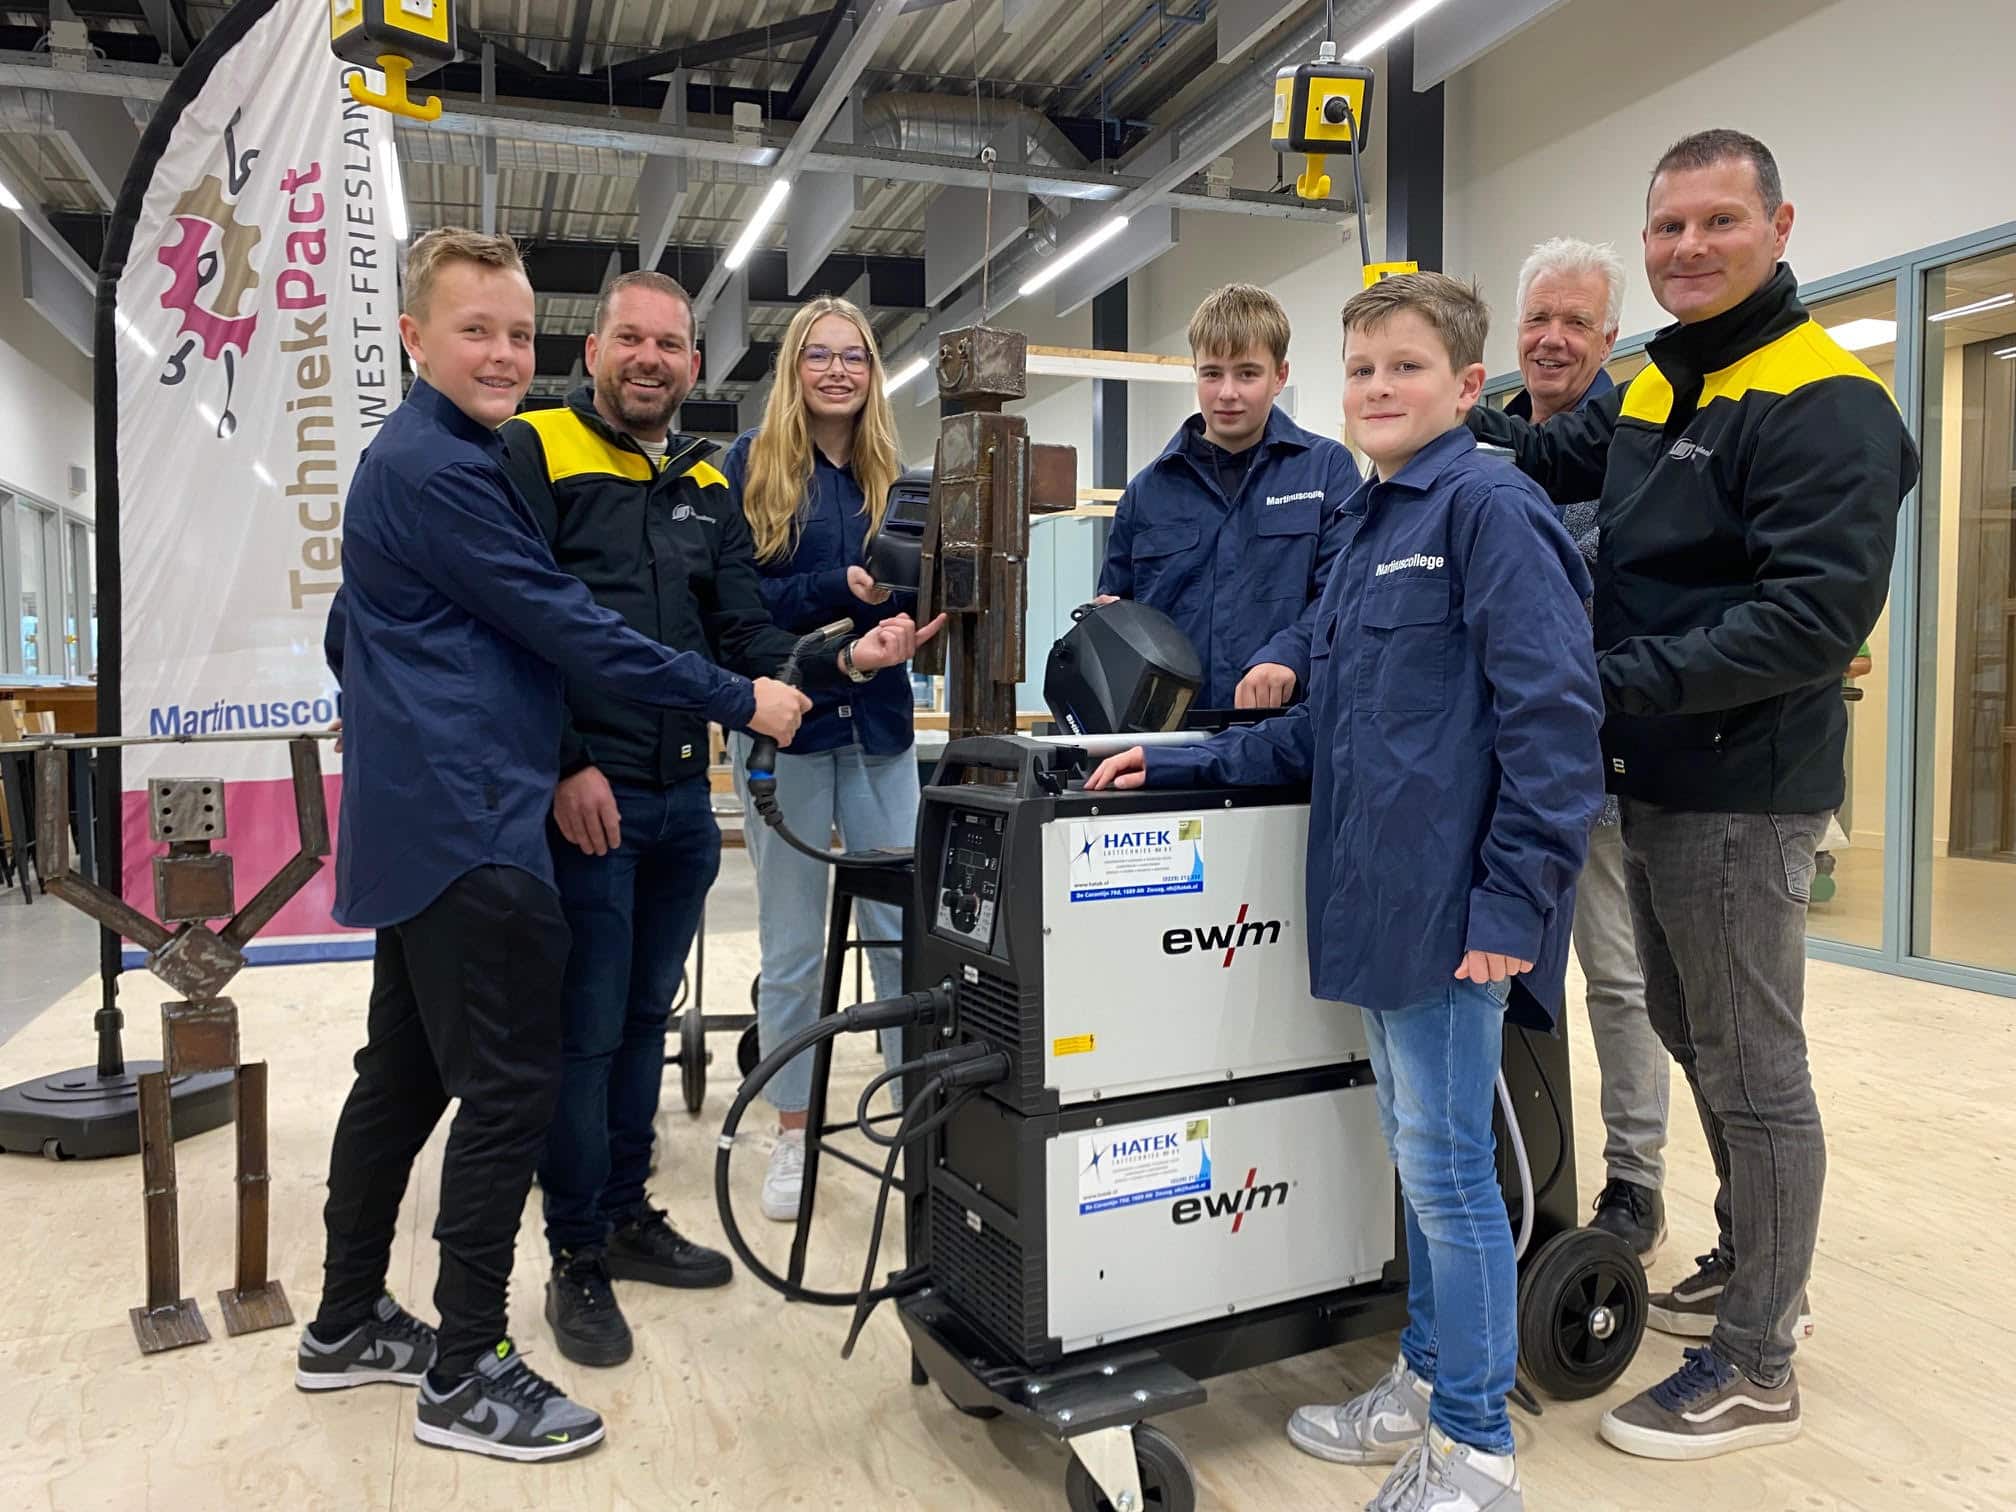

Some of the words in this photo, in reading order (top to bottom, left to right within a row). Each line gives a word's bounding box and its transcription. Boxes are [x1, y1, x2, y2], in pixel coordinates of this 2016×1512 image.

[276, 161, 343, 609] TechniekPact
[1104, 830, 1171, 848] HATEK
[1112, 1132, 1178, 1158] HATEK
